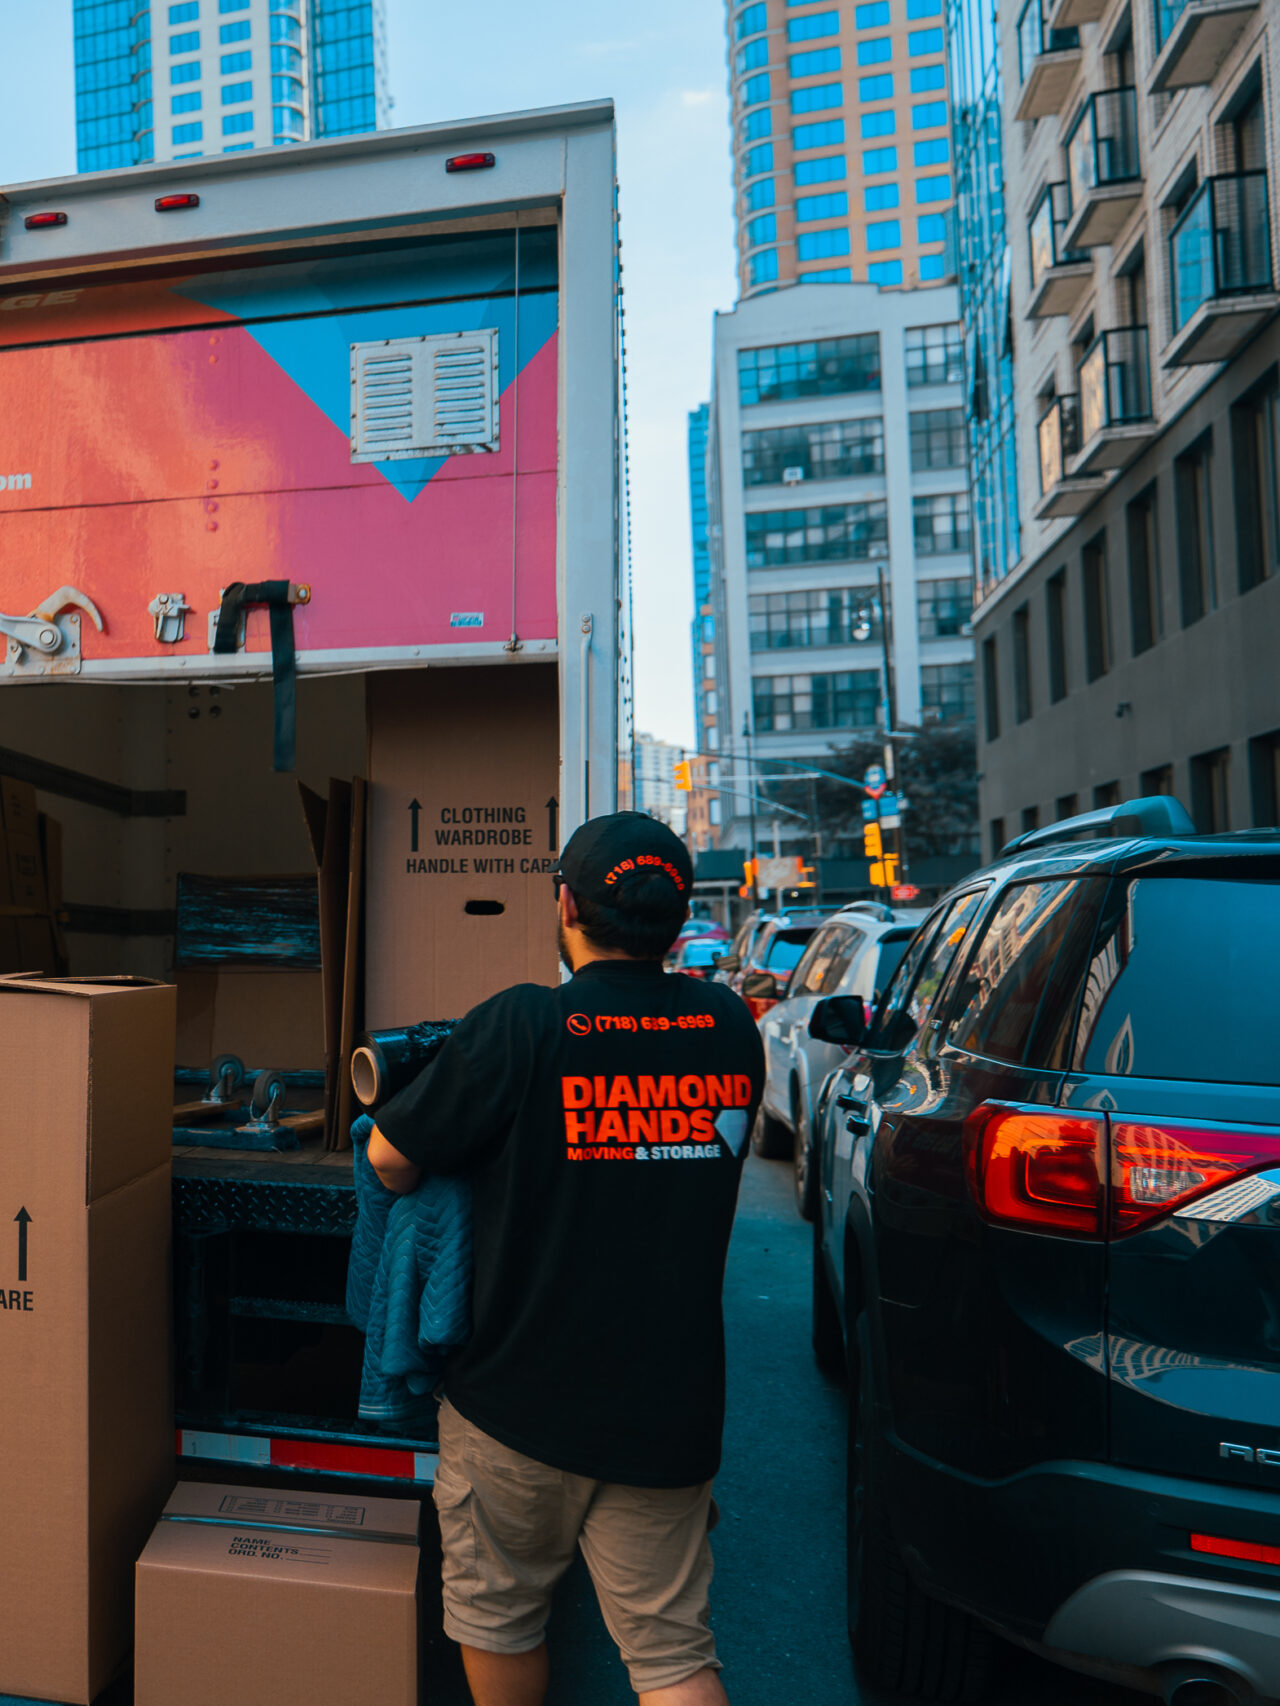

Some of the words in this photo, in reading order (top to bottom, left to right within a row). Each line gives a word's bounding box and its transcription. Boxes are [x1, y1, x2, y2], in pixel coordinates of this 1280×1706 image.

[440, 807, 526, 824] CLOTHING
[435, 829, 532, 846] WARDROBE
[406, 858, 469, 873] HANDLE
[473, 858, 515, 873] WITH
[604, 859, 636, 885] (718)
[595, 1015, 638, 1033] (718)
[641, 1015, 715, 1031] 689-6969
[561, 1075, 752, 1109] DIAMOND
[564, 1109, 715, 1143] HANDS
[567, 1147, 634, 1160] MOVING
[634, 1146, 650, 1160] &
[650, 1145, 721, 1159] STORAGE
[231, 1542, 299, 1555] CONTENTS
[233, 1536, 272, 1546] NAME
[261, 1551, 284, 1561] NO.
